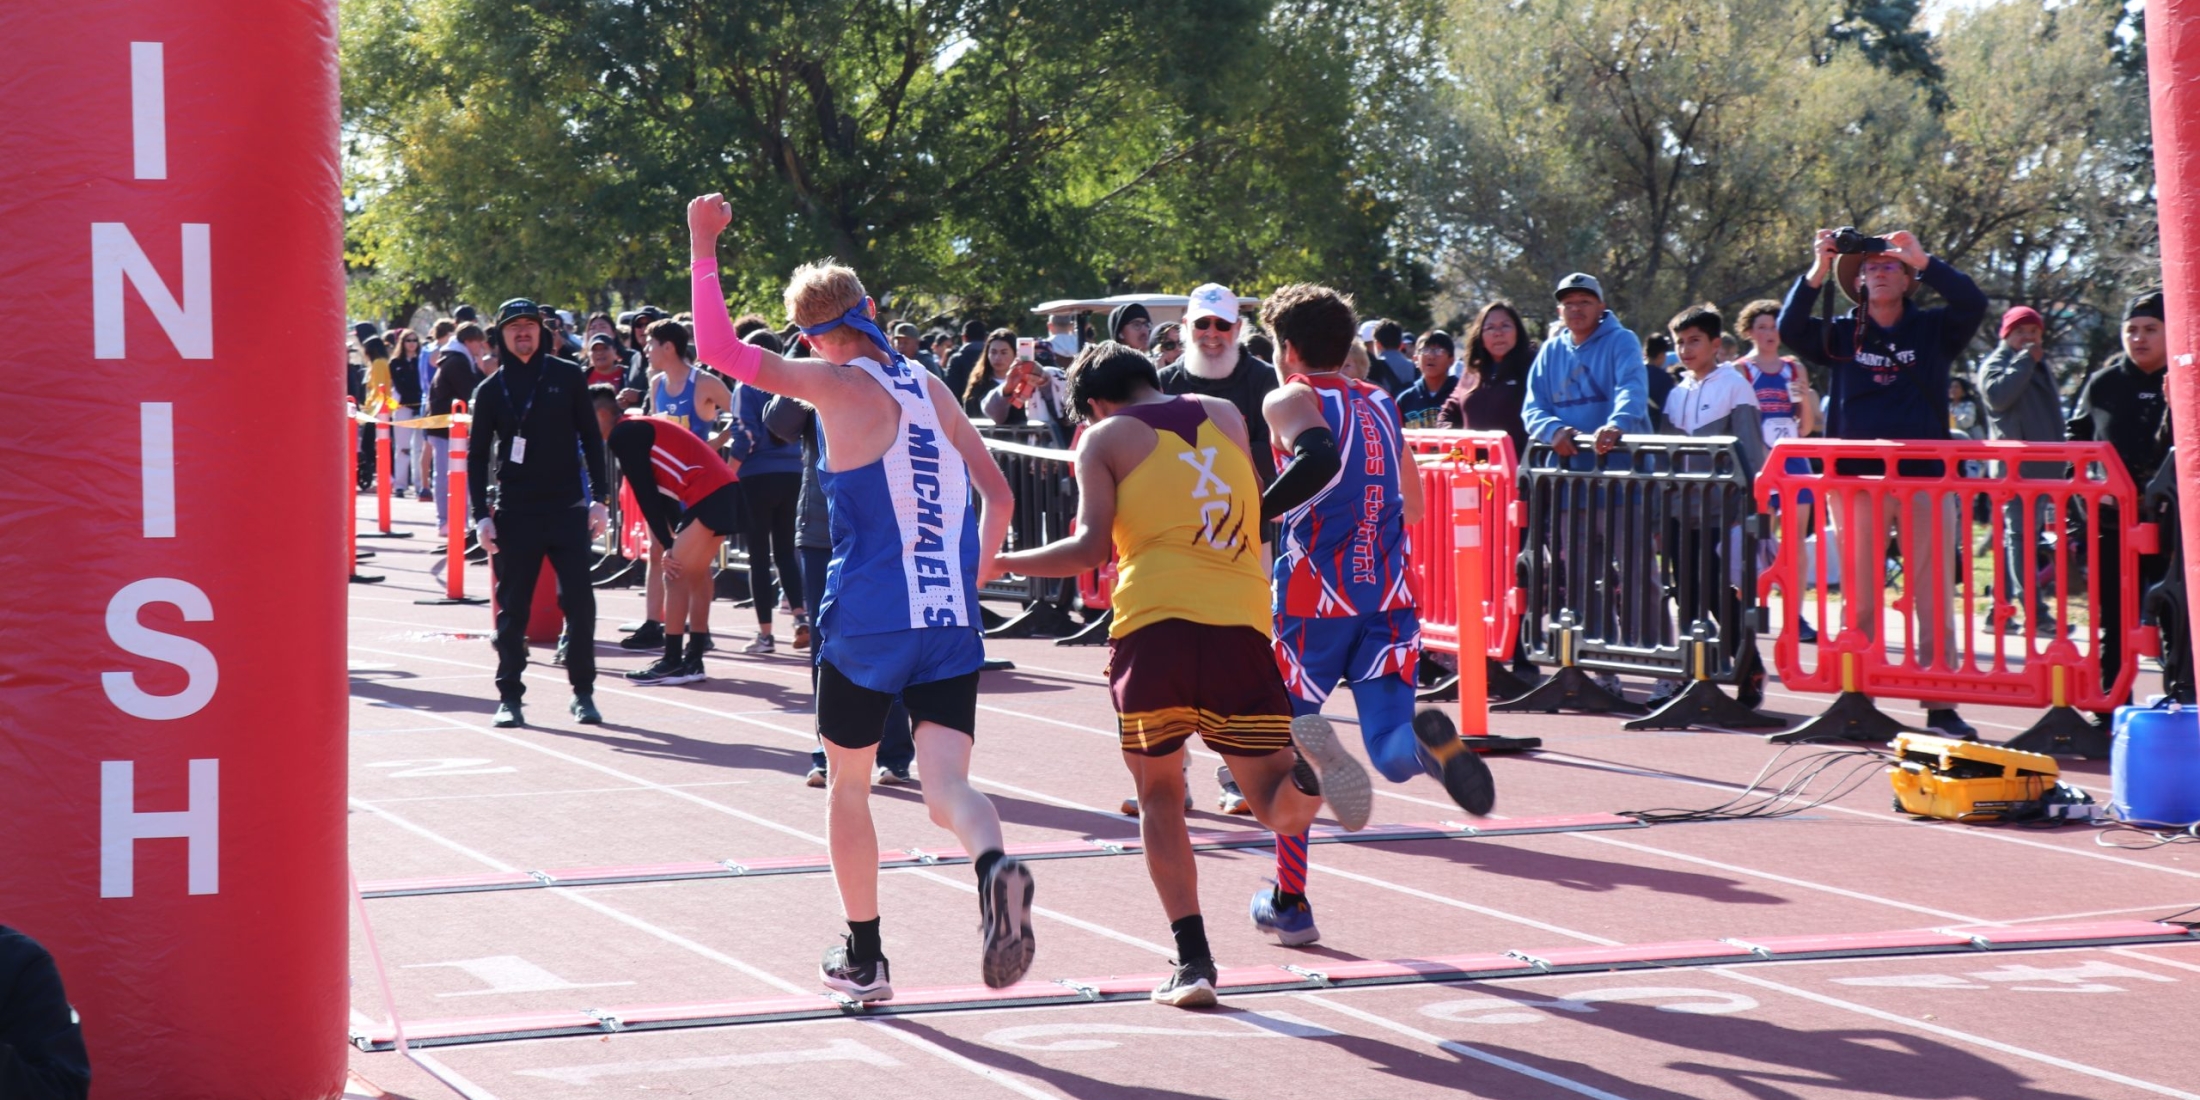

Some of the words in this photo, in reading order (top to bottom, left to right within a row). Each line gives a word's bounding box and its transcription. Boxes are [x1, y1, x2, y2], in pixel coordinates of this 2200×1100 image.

[1352, 399, 1385, 476] CROSS
[907, 422, 957, 627] MICHAEL'S
[1352, 484, 1385, 585] COUNTRY
